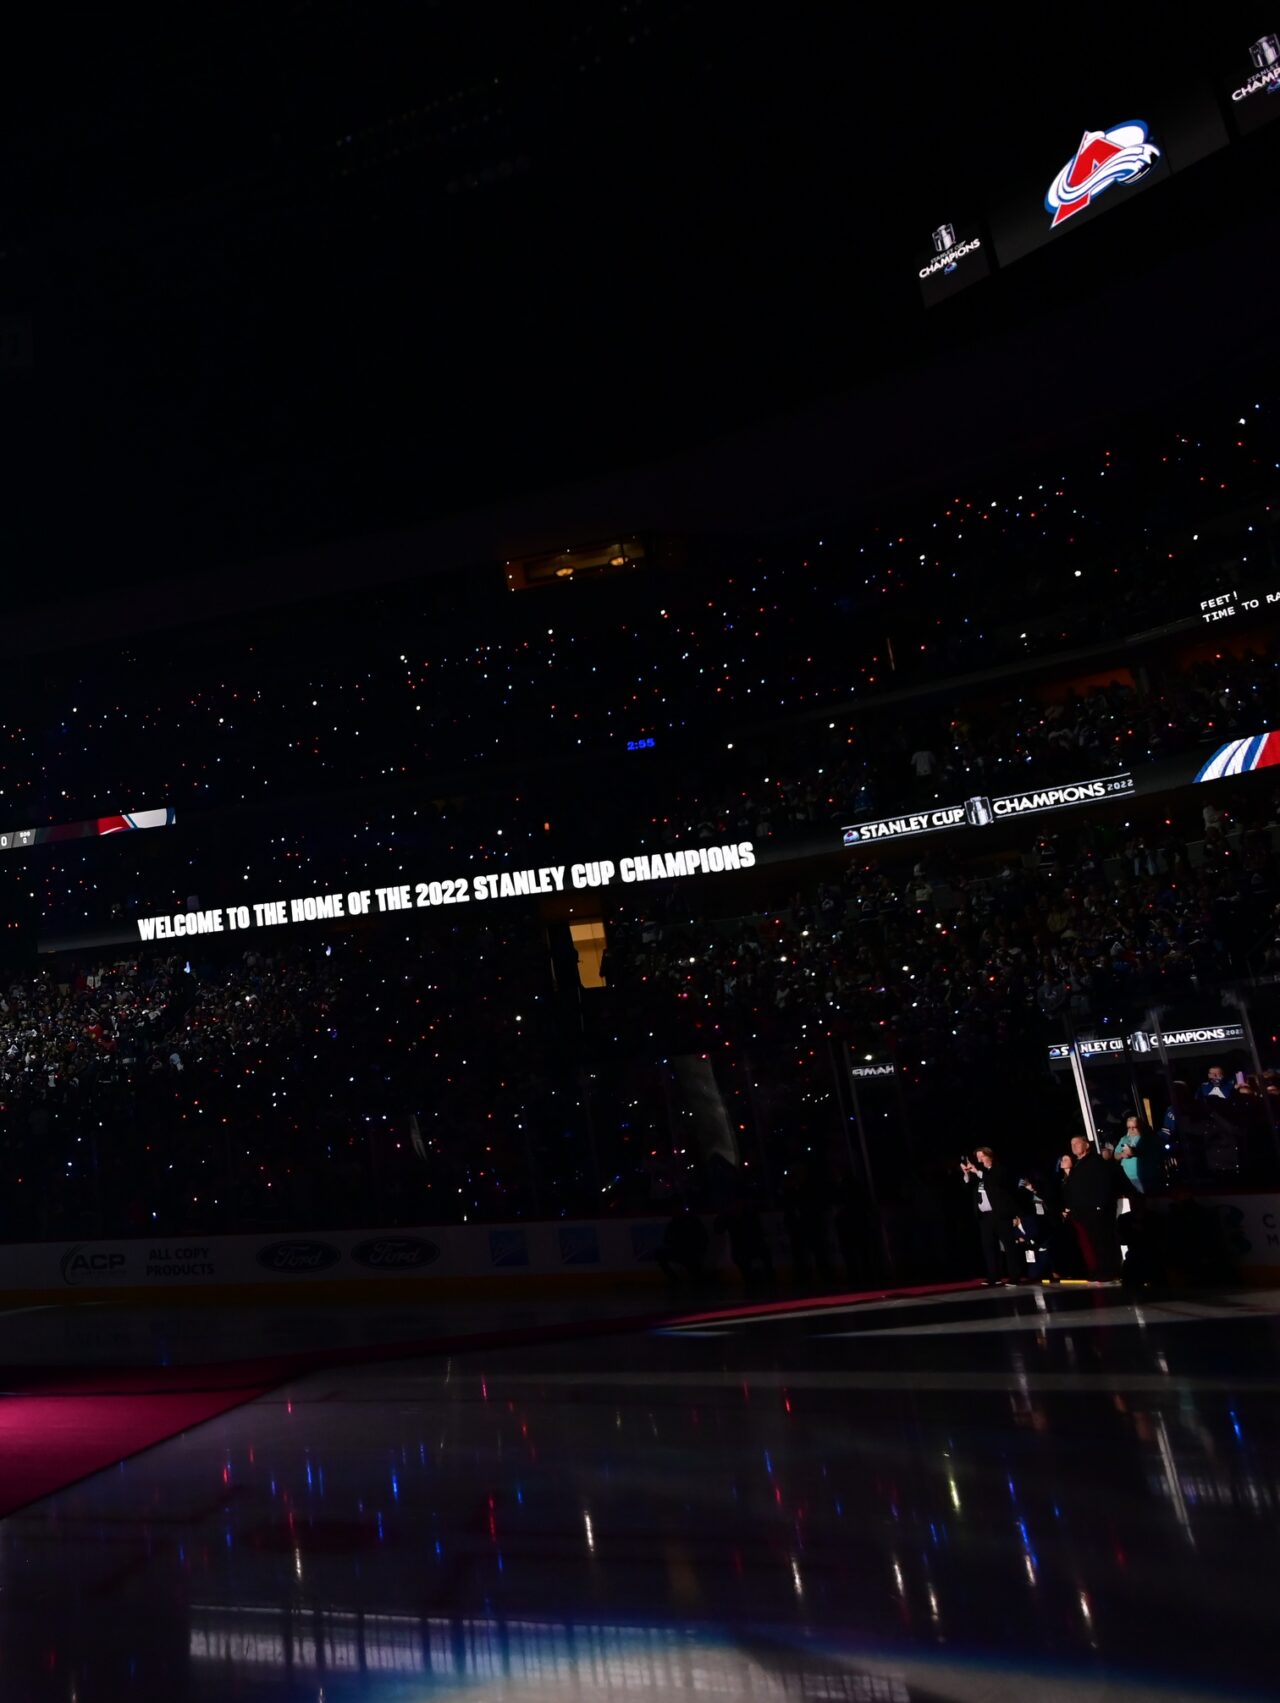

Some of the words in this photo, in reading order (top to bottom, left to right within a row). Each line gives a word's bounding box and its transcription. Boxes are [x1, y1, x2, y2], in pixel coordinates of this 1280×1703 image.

[918, 238, 981, 278] CHAMPIONS
[1200, 590, 1238, 611] FEET!
[1202, 606, 1236, 623] TIME
[1241, 599, 1260, 611] TO
[993, 781, 1106, 817] CHAMPIONS
[1106, 777, 1134, 792] 2022
[859, 813, 930, 841] STANLEY
[931, 807, 965, 827] CUP
[137, 909, 223, 941] WELCOME
[226, 906, 250, 930] TO
[253, 901, 288, 927] THE
[291, 894, 345, 923] HOME
[348, 890, 371, 915] OF
[375, 885, 413, 912] THE
[415, 878, 470, 908] 2022
[472, 866, 565, 901] STANLEY
[571, 860, 615, 889] CUP
[619, 841, 756, 884] CHAMPIONS
[1060, 1040, 1108, 1056] SNLEY
[1150, 1028, 1226, 1046] CHAMPIONS
[71, 1253, 126, 1271] ACP
[148, 1248, 171, 1261] ALL
[174, 1247, 210, 1260] COPY
[272, 1244, 322, 1268] Ford
[368, 1241, 421, 1265] Ford
[145, 1262, 215, 1277] PRODUCTS
